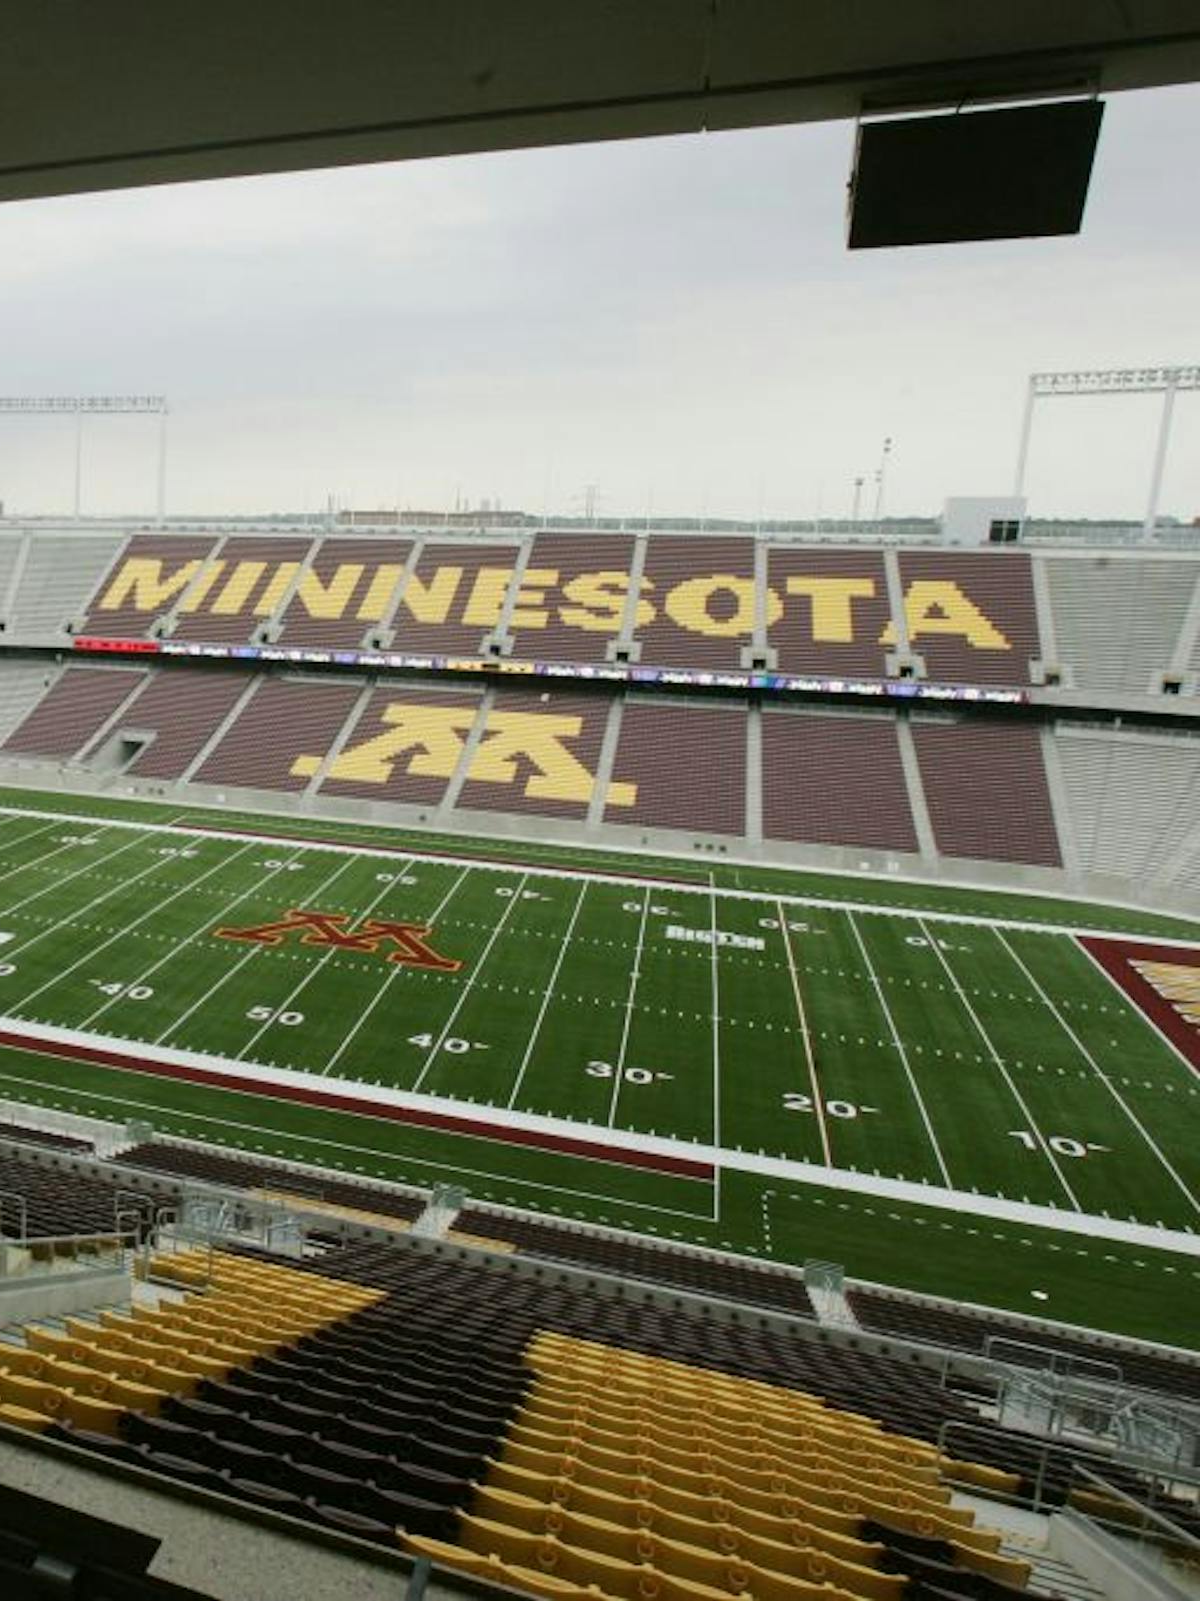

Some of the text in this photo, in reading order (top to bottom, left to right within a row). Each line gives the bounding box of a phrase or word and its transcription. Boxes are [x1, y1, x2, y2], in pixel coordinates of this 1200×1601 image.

[99, 556, 1013, 651] MINNESOTA
[97, 980, 154, 1000] 40
[246, 1004, 305, 1026] 50
[407, 1032, 471, 1054] 40
[585, 1060, 654, 1085] 30
[781, 1092, 859, 1120] 20
[1008, 1130, 1088, 1159] 10
